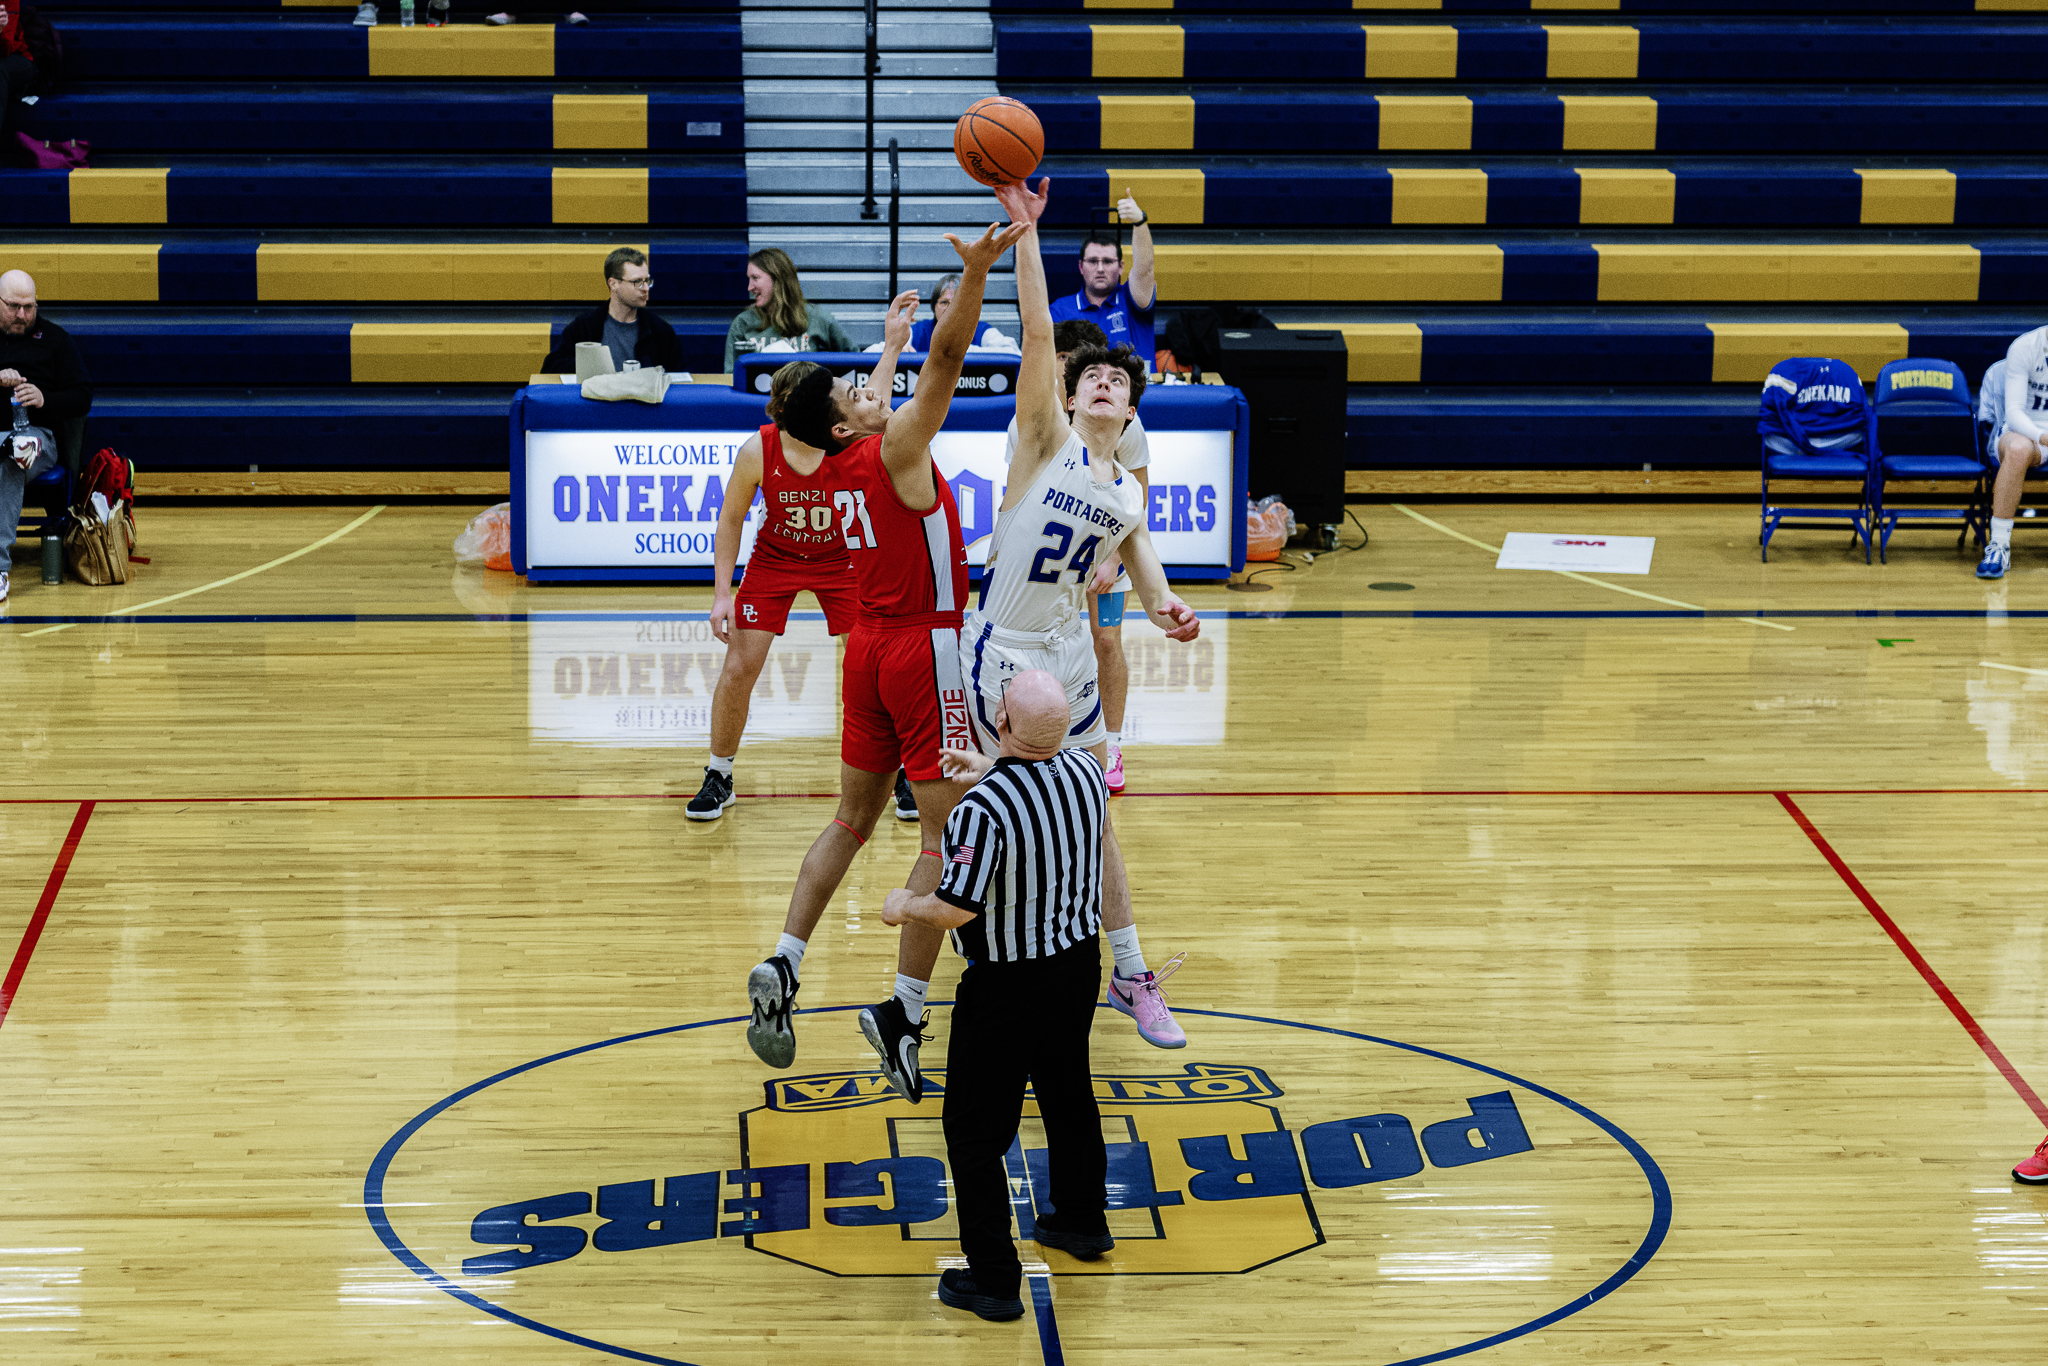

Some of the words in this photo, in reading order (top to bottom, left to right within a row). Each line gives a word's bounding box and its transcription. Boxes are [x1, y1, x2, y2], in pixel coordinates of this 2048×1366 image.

[955, 376, 987, 390] ONUS
[1890, 370, 1953, 391] PORTAGERS
[614, 444, 720, 466] WELCOME
[723, 444, 739, 466] T
[553, 474, 764, 523] ONEKA
[778, 489, 827, 503] BENZI
[784, 505, 832, 532] 30
[833, 489, 879, 550] 21
[1041, 487, 1125, 537] PORTAGERS
[1027, 520, 1105, 584] 24
[742, 603, 758, 623] BC
[942, 688, 968, 752] ENZIE
